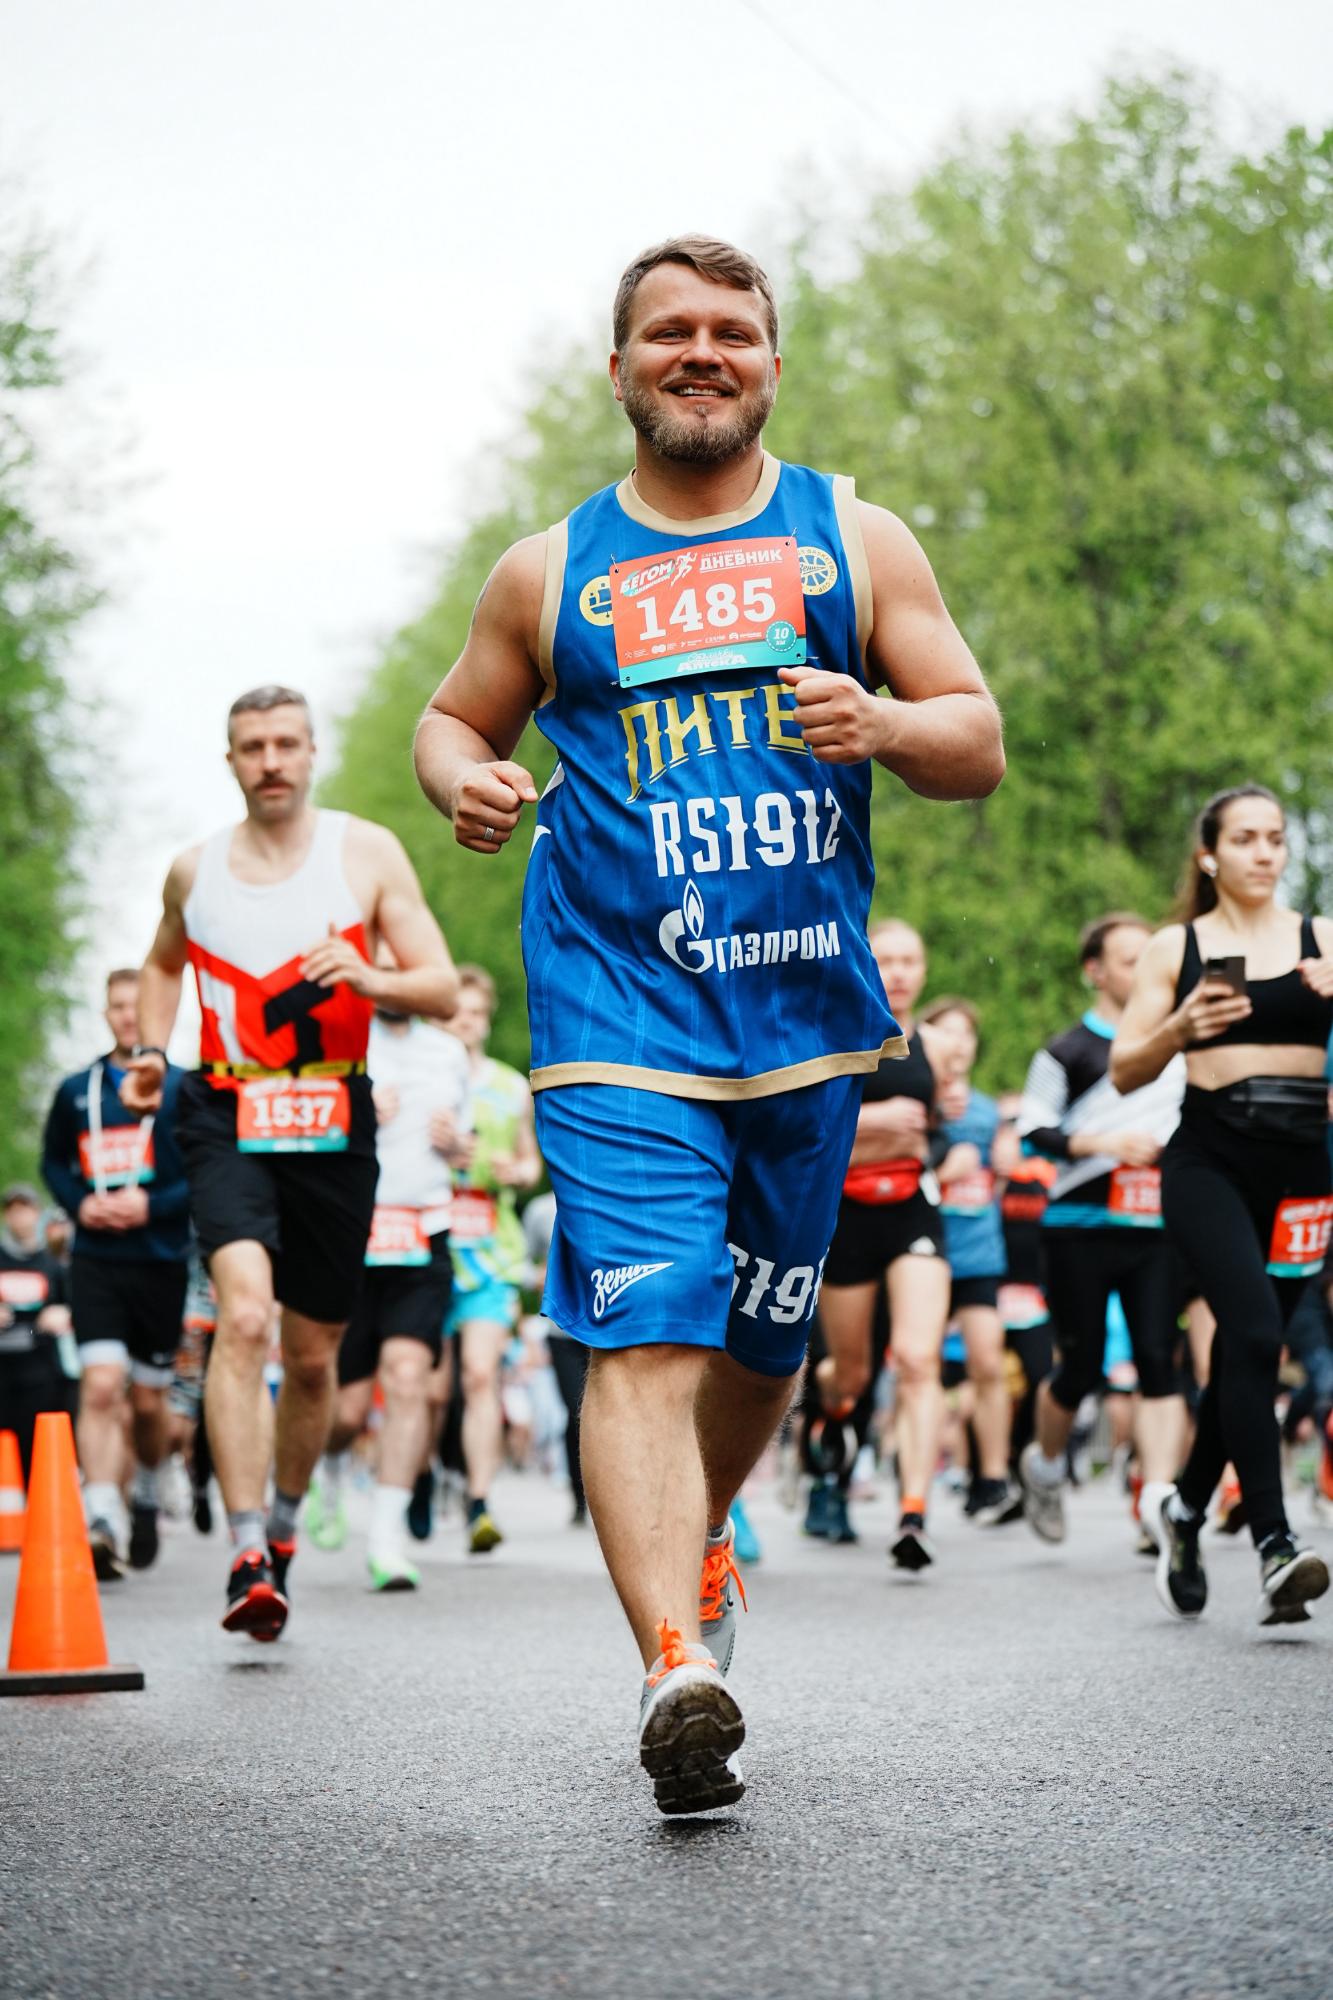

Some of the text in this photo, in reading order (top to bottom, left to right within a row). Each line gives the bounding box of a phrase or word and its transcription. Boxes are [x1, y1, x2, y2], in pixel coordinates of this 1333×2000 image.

[620, 560, 673, 594] БЕГОМ
[700, 549, 783, 571] ДНЕВНИК
[636, 577, 776, 641] 1485
[773, 627, 789, 639] 10
[618, 683, 810, 804] ПИТЕ
[649, 787, 842, 878] RS1912
[715, 921, 841, 973] ГАЗПРОМ
[252, 1095, 336, 1128] 1537
[591, 1261, 674, 1318] Зенит
